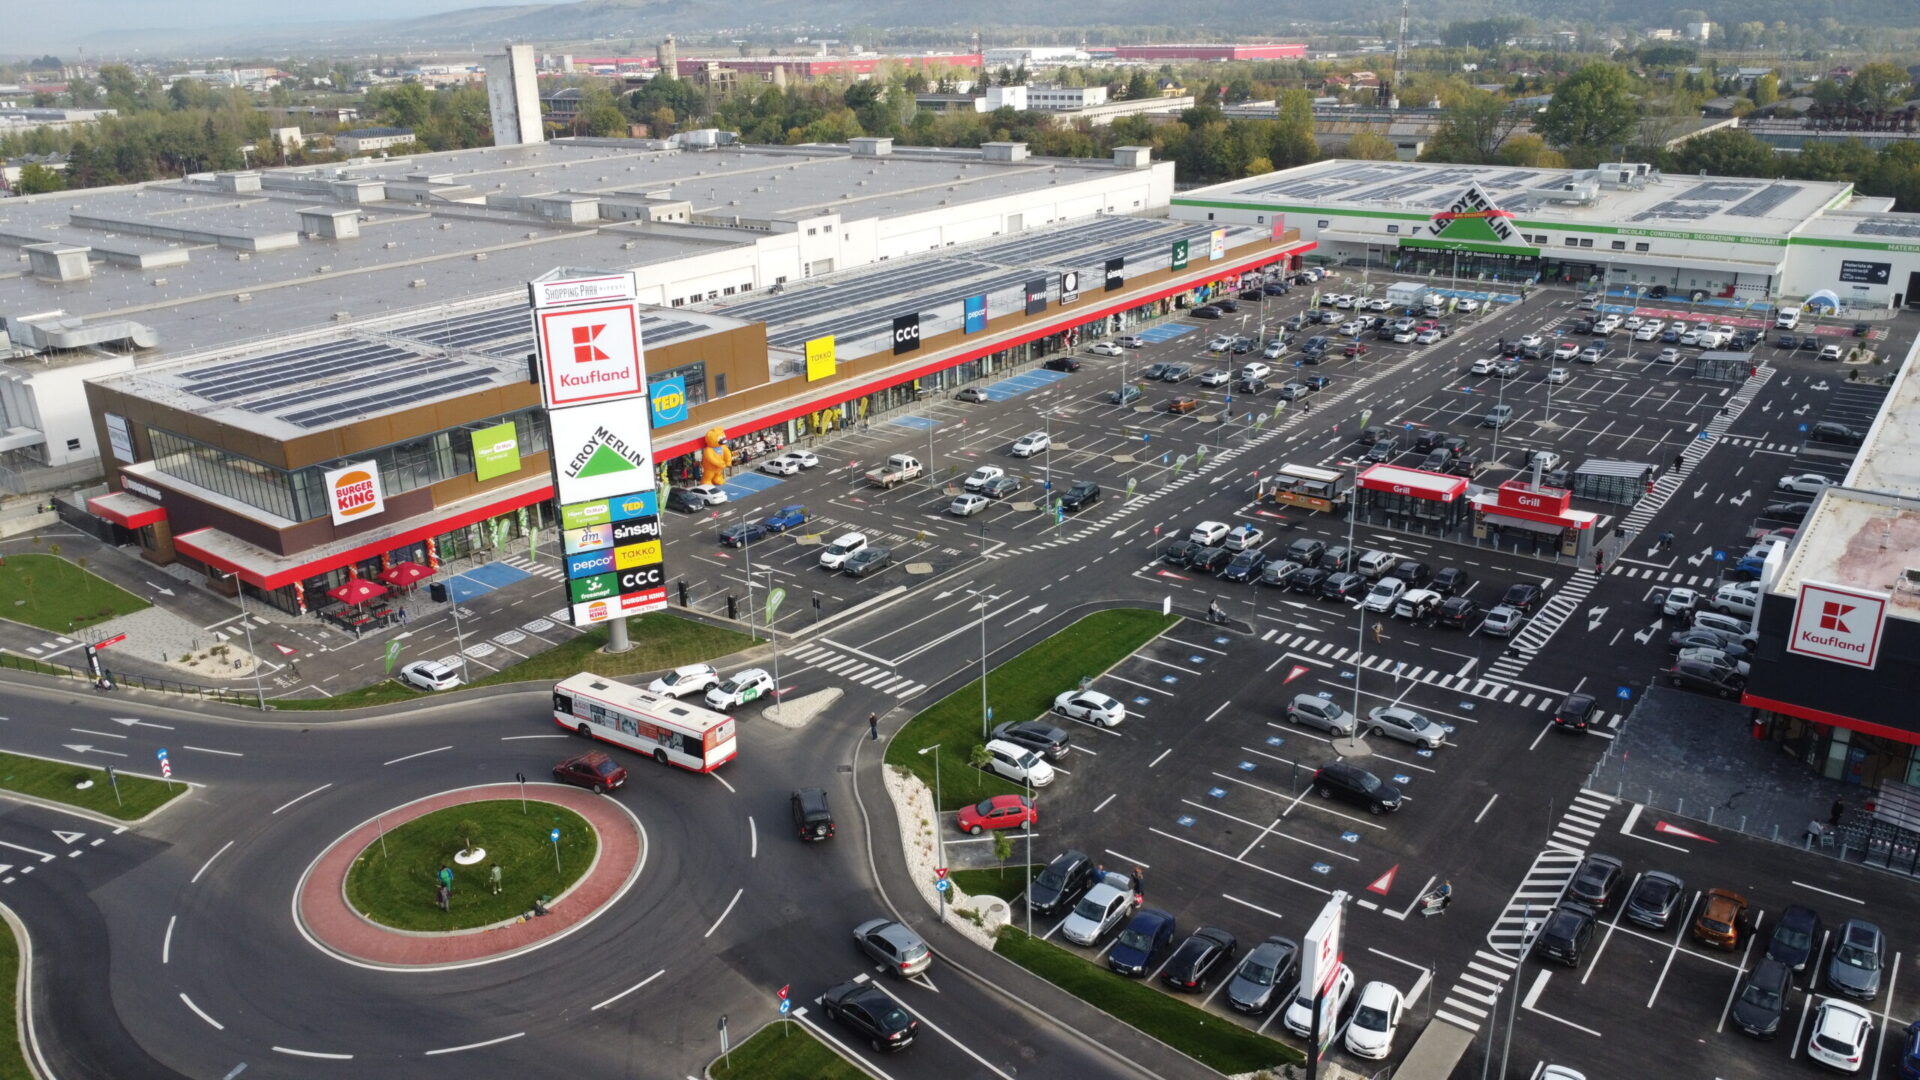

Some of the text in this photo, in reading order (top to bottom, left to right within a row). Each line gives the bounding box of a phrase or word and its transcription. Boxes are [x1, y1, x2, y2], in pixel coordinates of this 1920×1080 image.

[896, 325, 919, 342] CCC
[560, 366, 630, 387] Kaufland
[565, 426, 645, 478] LEROY MERLIN
[336, 481, 373, 498] BURGER
[1393, 485, 1410, 494] Grill
[338, 490, 375, 510] KING
[1518, 495, 1540, 507] Grill
[614, 522, 658, 539] sinsay
[573, 557, 610, 572] pepco
[622, 569, 659, 587] CCC
[1802, 630, 1865, 653] Kaufland
